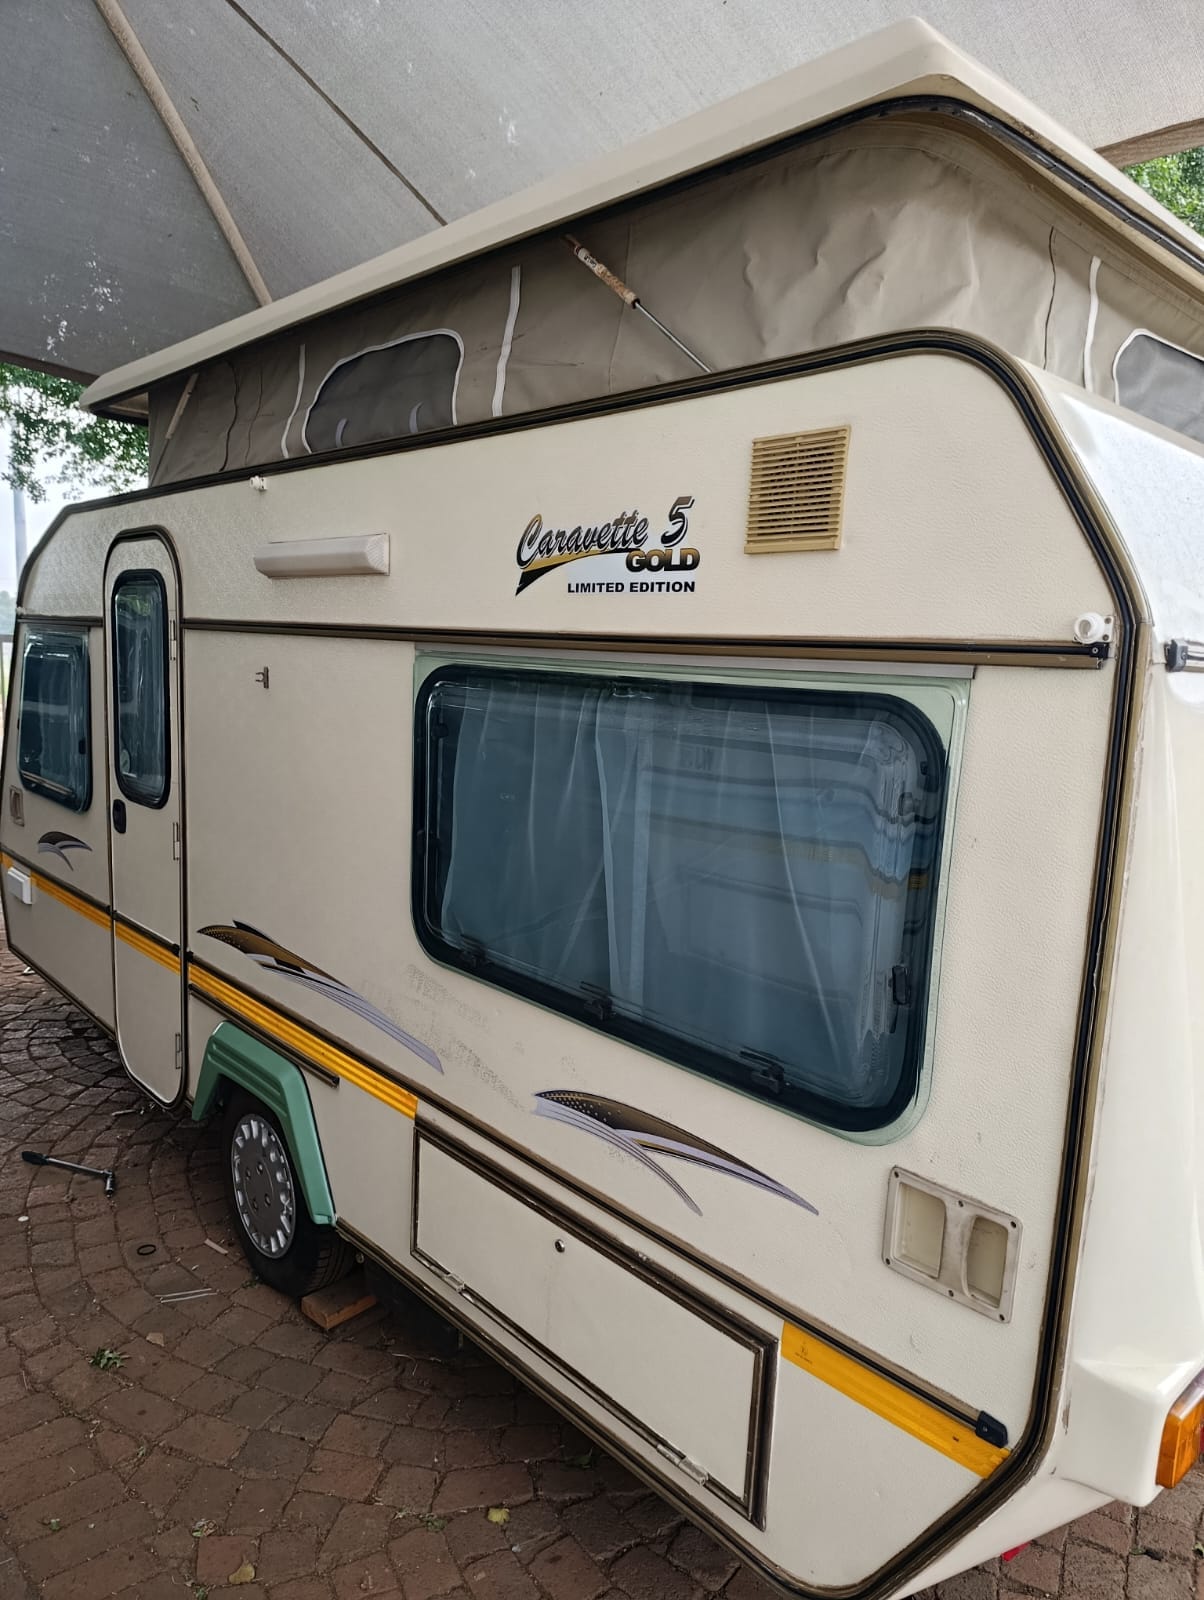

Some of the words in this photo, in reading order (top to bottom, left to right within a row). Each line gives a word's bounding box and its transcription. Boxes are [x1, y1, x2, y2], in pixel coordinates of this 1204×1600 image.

[516, 509, 649, 569] Caravette
[660, 495, 695, 547] 5
[625, 548, 700, 572] GOLD
[567, 582, 625, 593] LIMITED
[629, 581, 695, 593] EDITION
